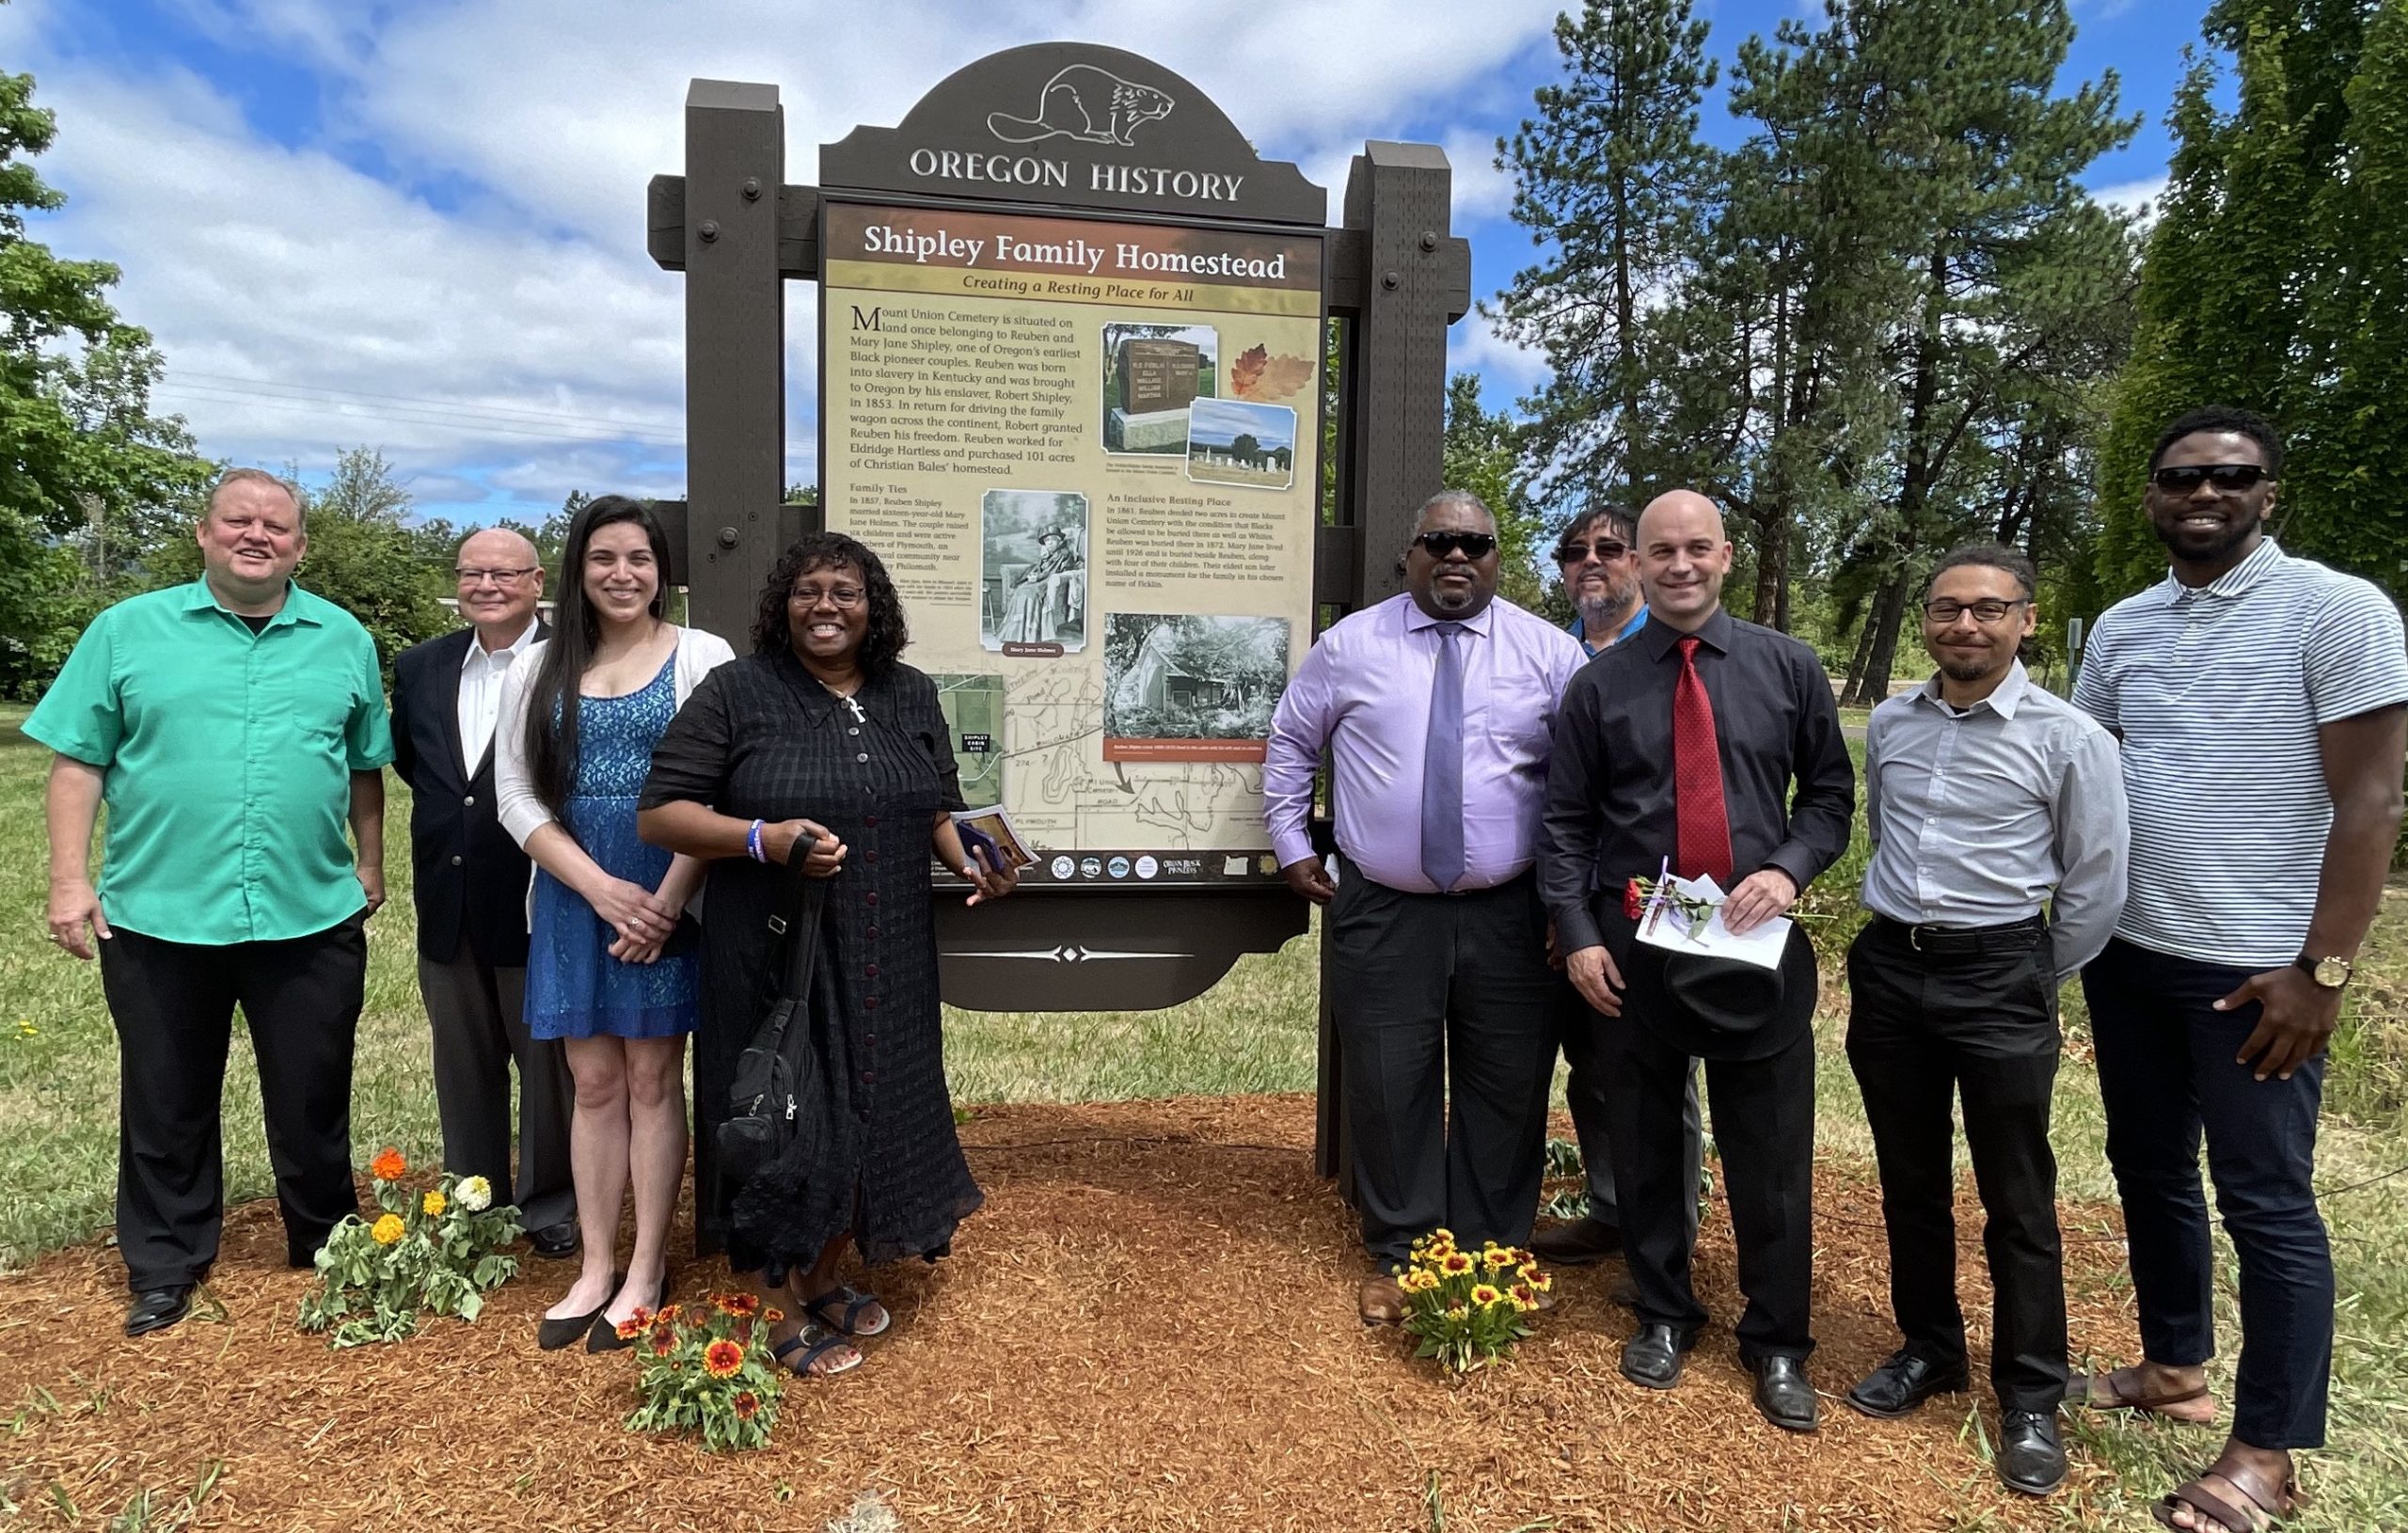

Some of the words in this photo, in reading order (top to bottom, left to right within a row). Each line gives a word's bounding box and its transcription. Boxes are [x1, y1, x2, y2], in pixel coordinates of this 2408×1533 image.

[910, 148, 1069, 187] OREGON
[1090, 163, 1244, 201] HISTORY
[864, 226, 984, 265] Shipley
[995, 235, 1105, 274] Family
[1116, 244, 1286, 279] Homestead
[962, 275, 1027, 294] Creating
[1033, 282, 1041, 292] a
[1047, 280, 1101, 299] Resting
[1105, 287, 1145, 299] Place
[1148, 287, 1169, 300] for
[1172, 289, 1194, 302] All
[911, 309, 945, 321] Union
[948, 311, 999, 326] Cemetery
[1002, 314, 1011, 324] is
[1013, 315, 1056, 327] situated
[882, 323, 907, 334] land
[910, 327, 936, 335] once
[939, 326, 993, 341] belonging
[996, 329, 1007, 339] to
[1011, 330, 1049, 342] Reuben
[1053, 332, 1074, 343] and
[850, 337, 879, 350] Mary
[883, 338, 908, 349] Jane
[911, 340, 953, 354] Shipley,
[979, 343, 991, 353] of
[1043, 347, 1080, 358] earliest
[850, 352, 880, 363] Black
[883, 354, 925, 368] pioneer
[927, 356, 971, 370] couples.
[975, 358, 1014, 370] Reuben
[1041, 362, 1066, 373] born
[850, 367, 872, 378] into
[875, 368, 914, 382] slavery
[918, 370, 928, 380] in
[932, 371, 982, 386] Kentucky
[985, 374, 1006, 384] and
[1033, 376, 1075, 390] brought
[850, 382, 861, 392] to
[864, 383, 905, 397] Oregon
[908, 385, 922, 398] by
[925, 386, 941, 396] his
[944, 387, 991, 400] enslaver,
[995, 389, 1029, 400] Robert
[1032, 391, 1073, 405] Shipley,
[850, 398, 861, 408] in
[866, 398, 895, 409] 1853.
[898, 400, 910, 410] In
[914, 401, 946, 412] return
[950, 402, 965, 412] for
[968, 403, 1006, 417] driving
[1010, 405, 1027, 415] the
[1030, 406, 1064, 420] family
[850, 415, 887, 427] wagon
[890, 418, 924, 426] across
[927, 416, 944, 427] the
[947, 417, 1001, 430] continent,
[1005, 420, 1038, 431] Robert
[1041, 422, 1082, 436] granted
[850, 428, 890, 439] Reuben
[894, 430, 910, 440] his
[914, 431, 960, 442] freedom.
[964, 433, 1003, 444] Reuben
[1007, 435, 1045, 446] worked
[1048, 437, 1063, 447] for
[850, 443, 894, 457] Eldridge
[897, 445, 940, 457] Hartless
[943, 447, 965, 457] and
[968, 448, 1022, 463] purchased
[1027, 450, 1044, 461] 101
[849, 458, 861, 468] of
[864, 459, 914, 470] Christian
[952, 463, 1013, 475] homestead.
[850, 483, 884, 495] Family
[887, 484, 907, 493] Ties
[1107, 494, 1120, 502] An
[1123, 495, 1166, 504] Inclusive
[1169, 496, 1203, 507] Resting
[1206, 498, 1231, 506] Place
